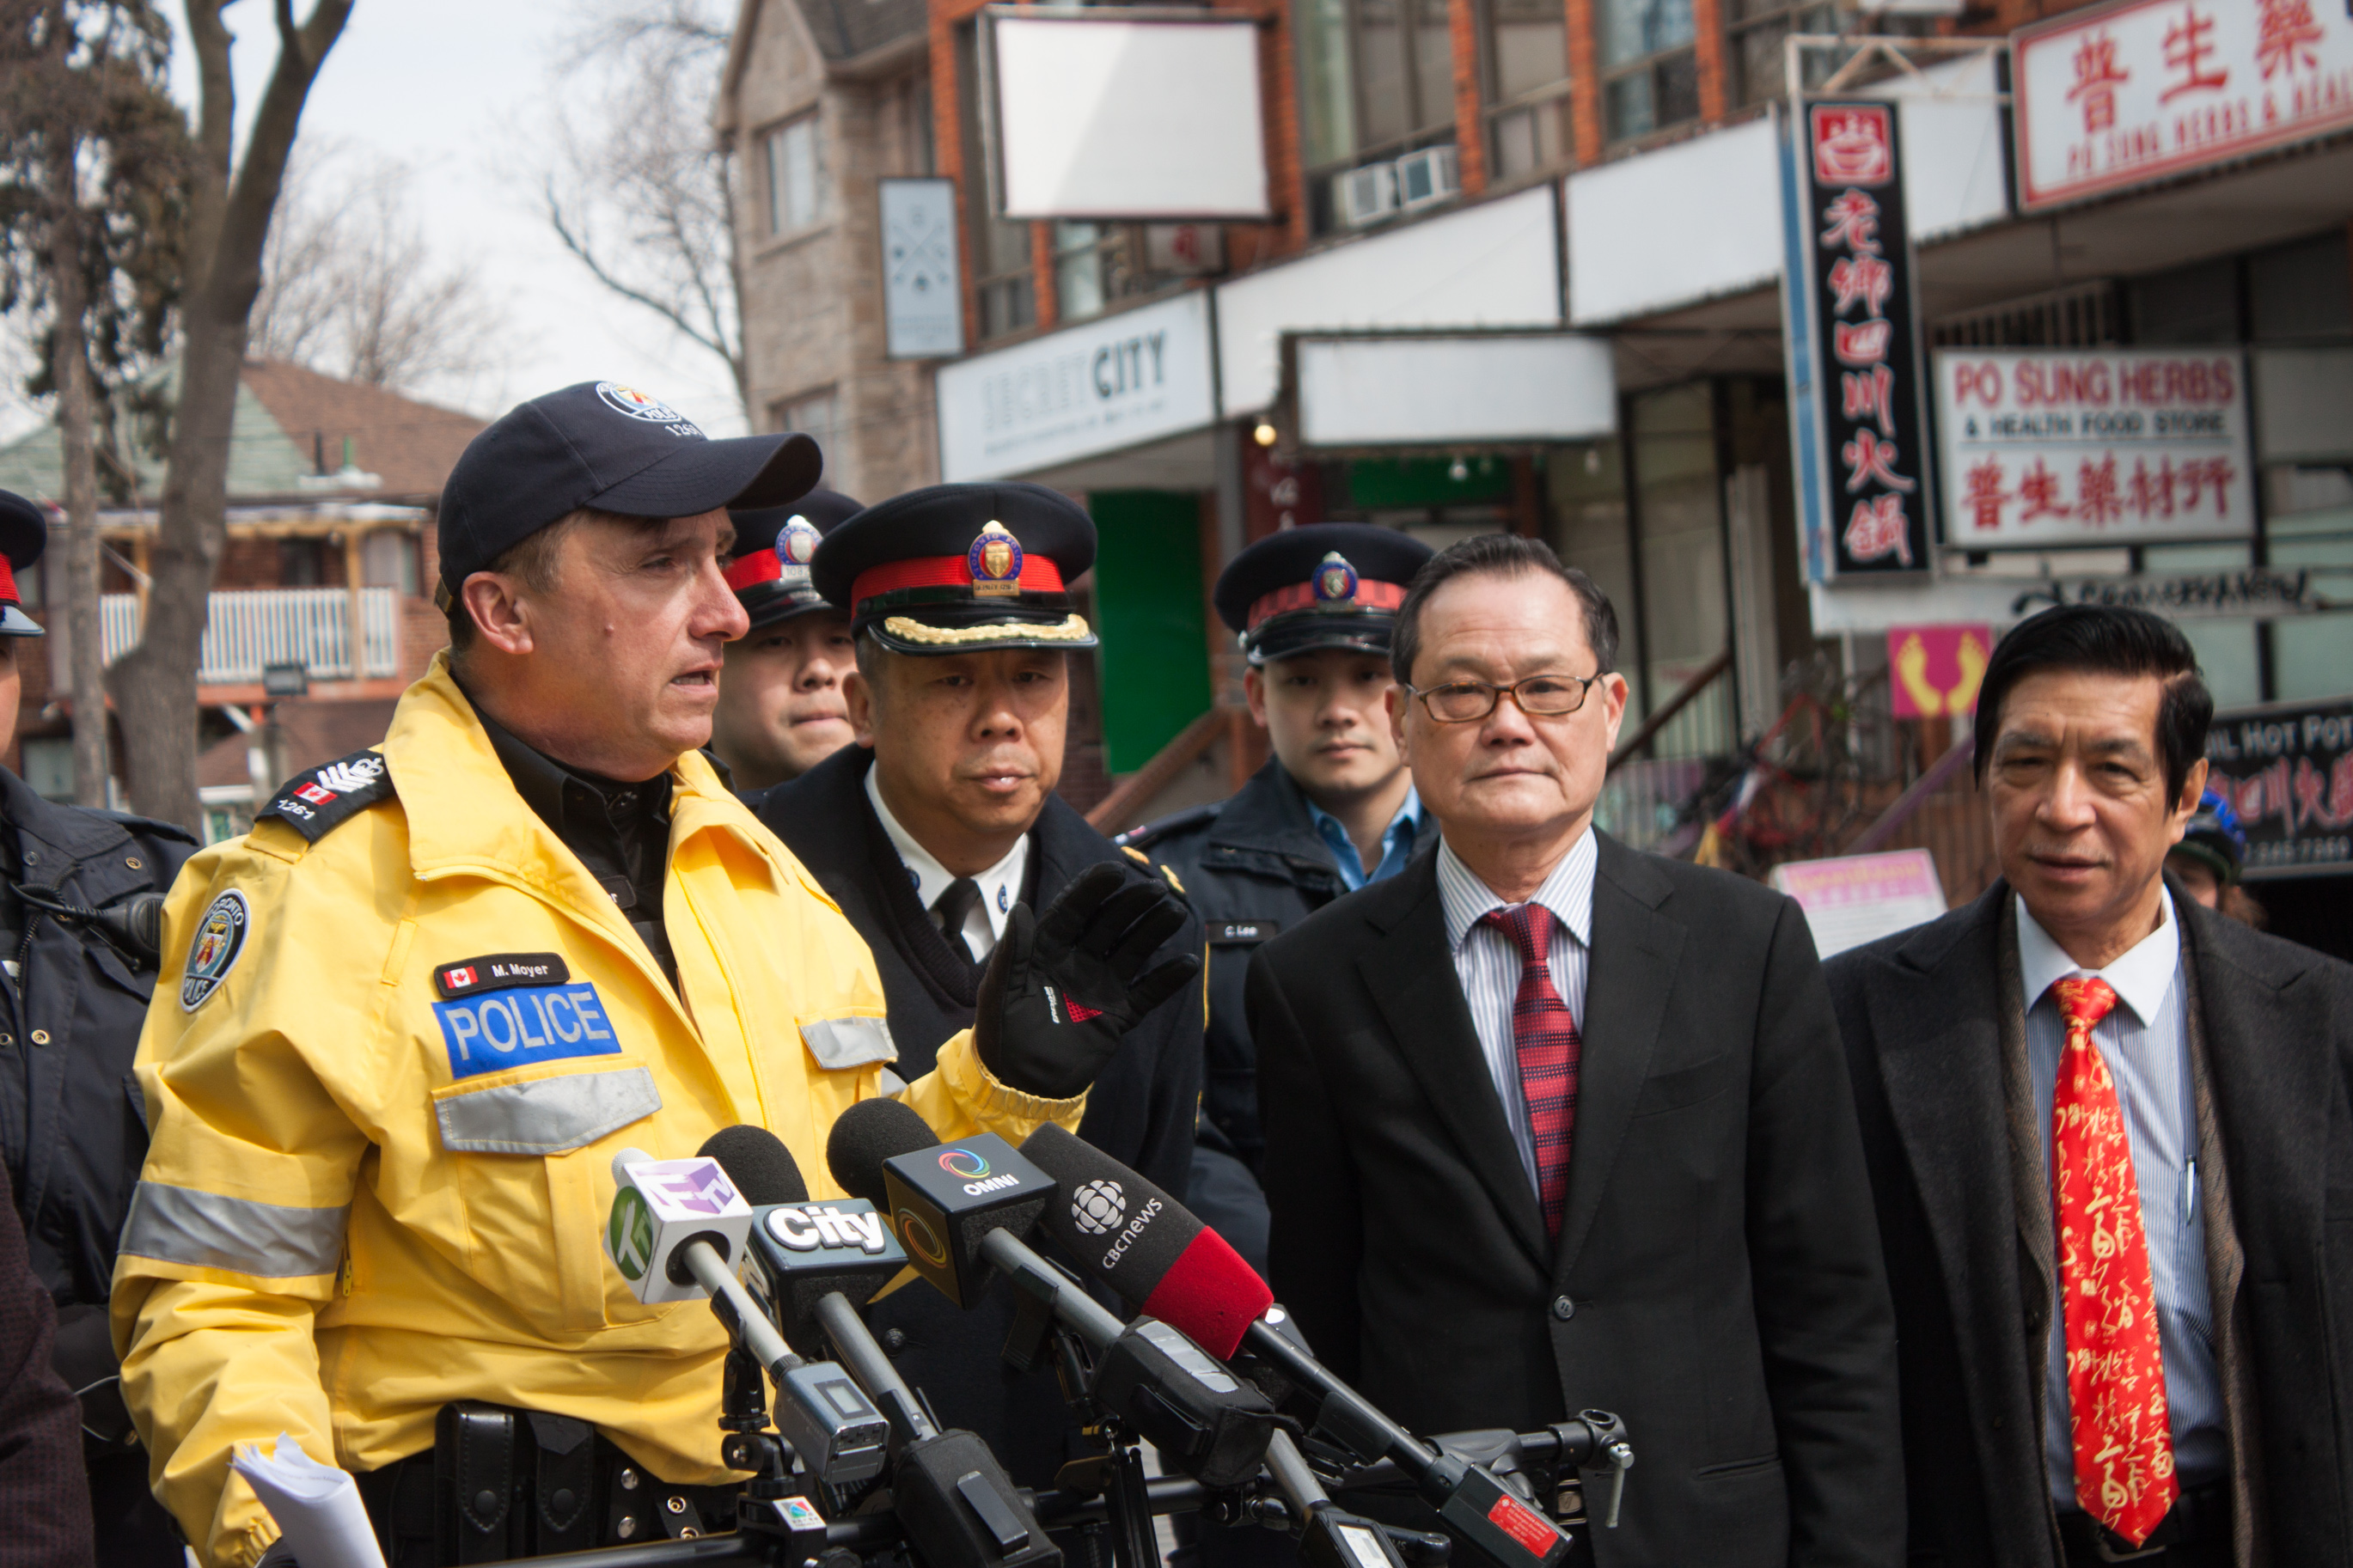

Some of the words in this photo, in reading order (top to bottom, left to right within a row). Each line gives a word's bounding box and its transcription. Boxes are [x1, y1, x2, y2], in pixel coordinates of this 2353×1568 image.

[1091, 326, 1166, 401] CITY
[1954, 359, 2002, 408] PO
[2014, 358, 2112, 408] SUNG
[2118, 357, 2234, 407] HERBS
[1989, 412, 2073, 437] HEALTH
[2081, 411, 2144, 434] FOOD
[2154, 408, 2227, 432] STORE
[2240, 721, 2297, 758] HOT
[277, 797, 315, 821] 1261
[206, 896, 245, 926] TORONTO
[492, 964, 510, 978] M.
[509, 963, 549, 978] Moyer
[182, 977, 210, 1004] POLICE
[444, 991, 611, 1061] POLICE
[963, 1173, 1020, 1197] OMNI
[767, 1205, 886, 1254] City
